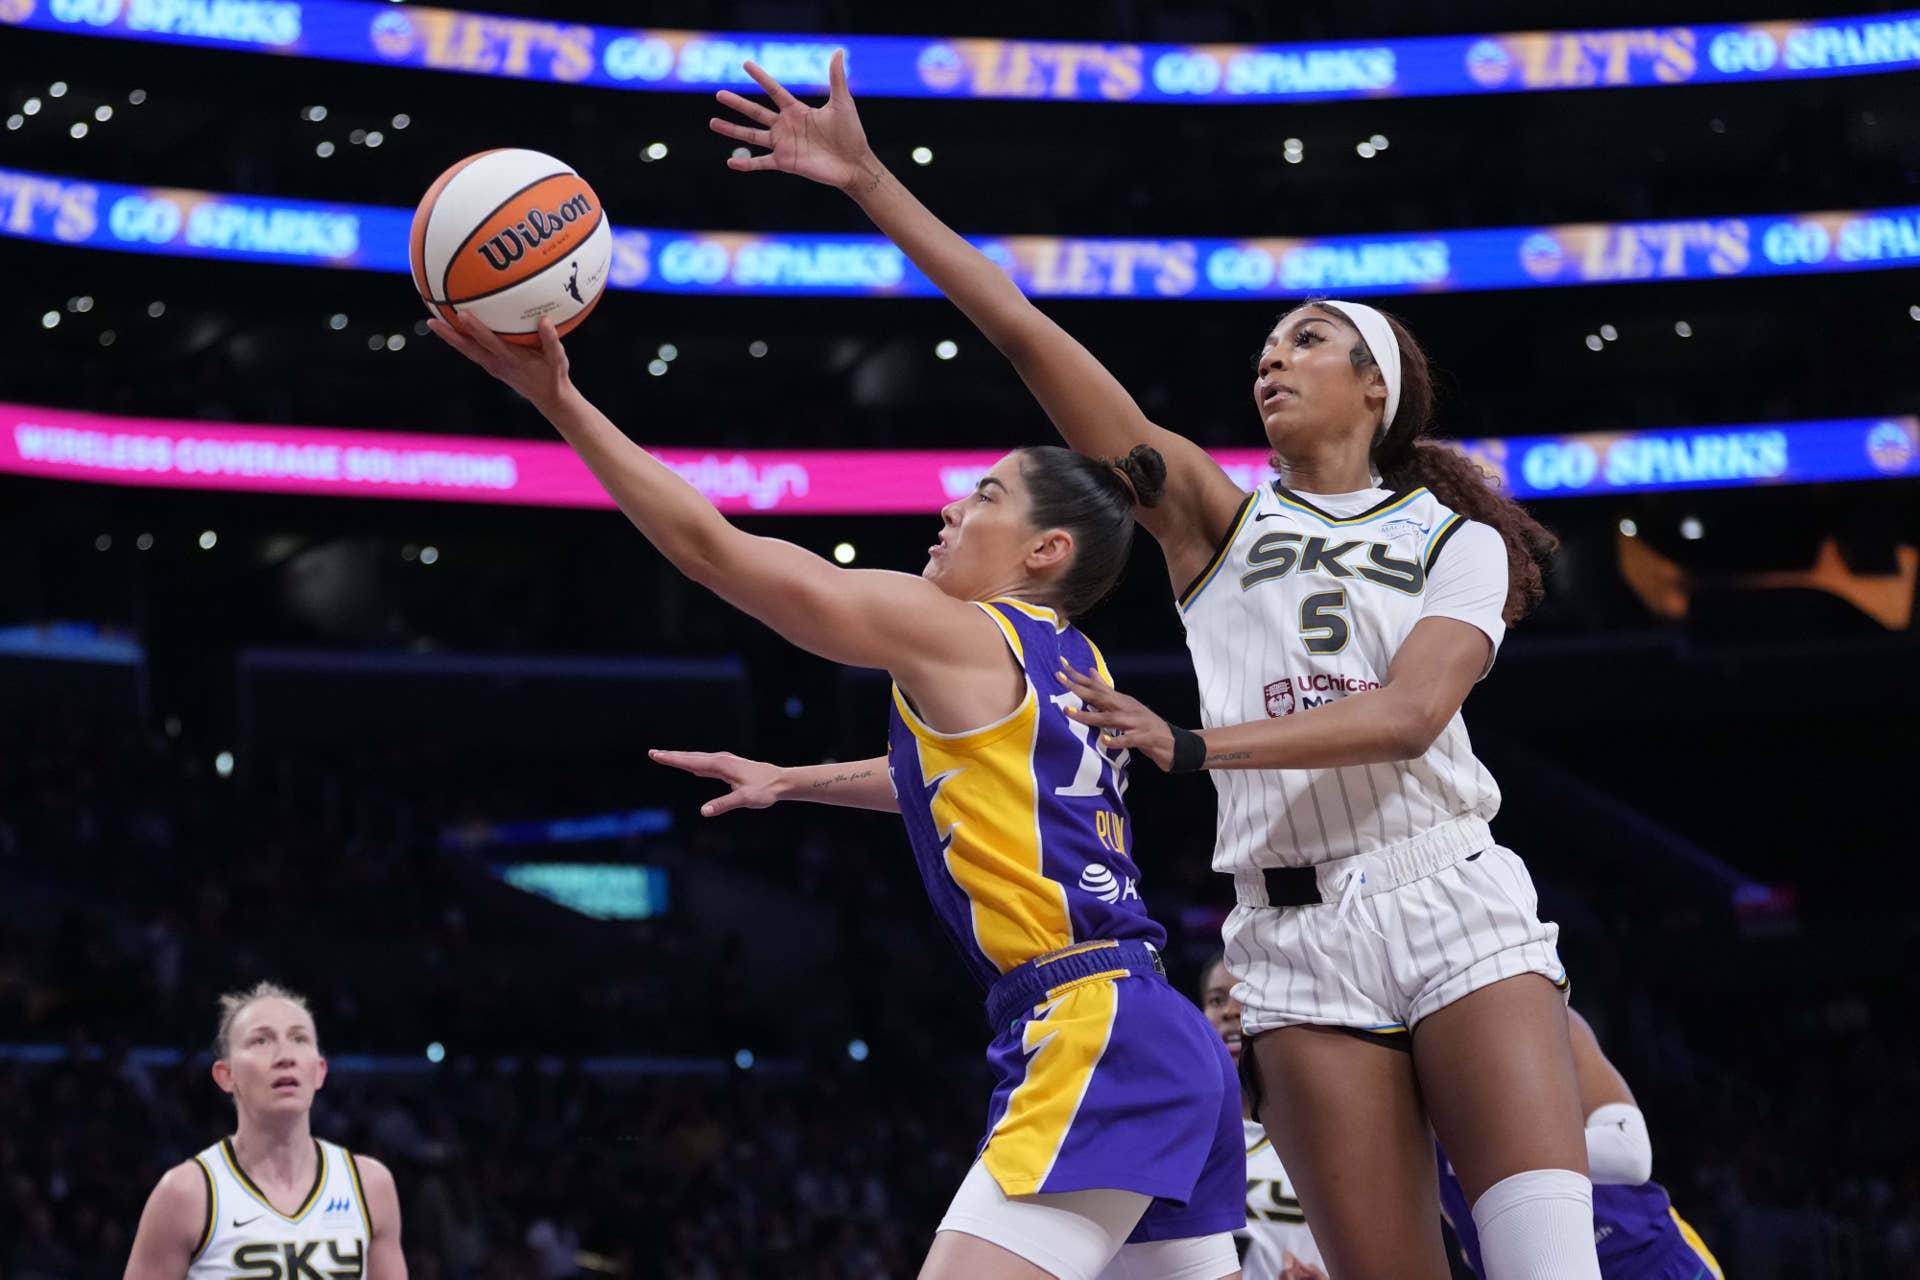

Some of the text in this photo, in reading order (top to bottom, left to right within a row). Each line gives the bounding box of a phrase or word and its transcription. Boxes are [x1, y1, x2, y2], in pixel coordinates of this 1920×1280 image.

[126, 0, 301, 45] SPARKS
[422, 16, 847, 84] LET'S GO SPARKS
[972, 38, 1396, 100] LET'S GO SPARKS
[1522, 27, 1697, 90] LET'S
[1708, 31, 1775, 73] GO
[109, 195, 181, 243] GO
[184, 203, 359, 258] SPARKS
[476, 193, 592, 271] Wilson
[1580, 215, 1920, 281] LET'S GO SPA
[658, 240, 729, 284] GO
[731, 242, 904, 287] SPARKS
[1032, 239, 1449, 298] LET'S GO SPARKS
[14, 422, 518, 489] WIRELESS COVERAGE SOLUTIONS
[1522, 442, 1597, 490] GO
[1604, 430, 1787, 486] SPARKS
[1239, 530, 1426, 597] SKY
[1299, 590, 1350, 656] 5
[229, 1238, 364, 1280] SKY
